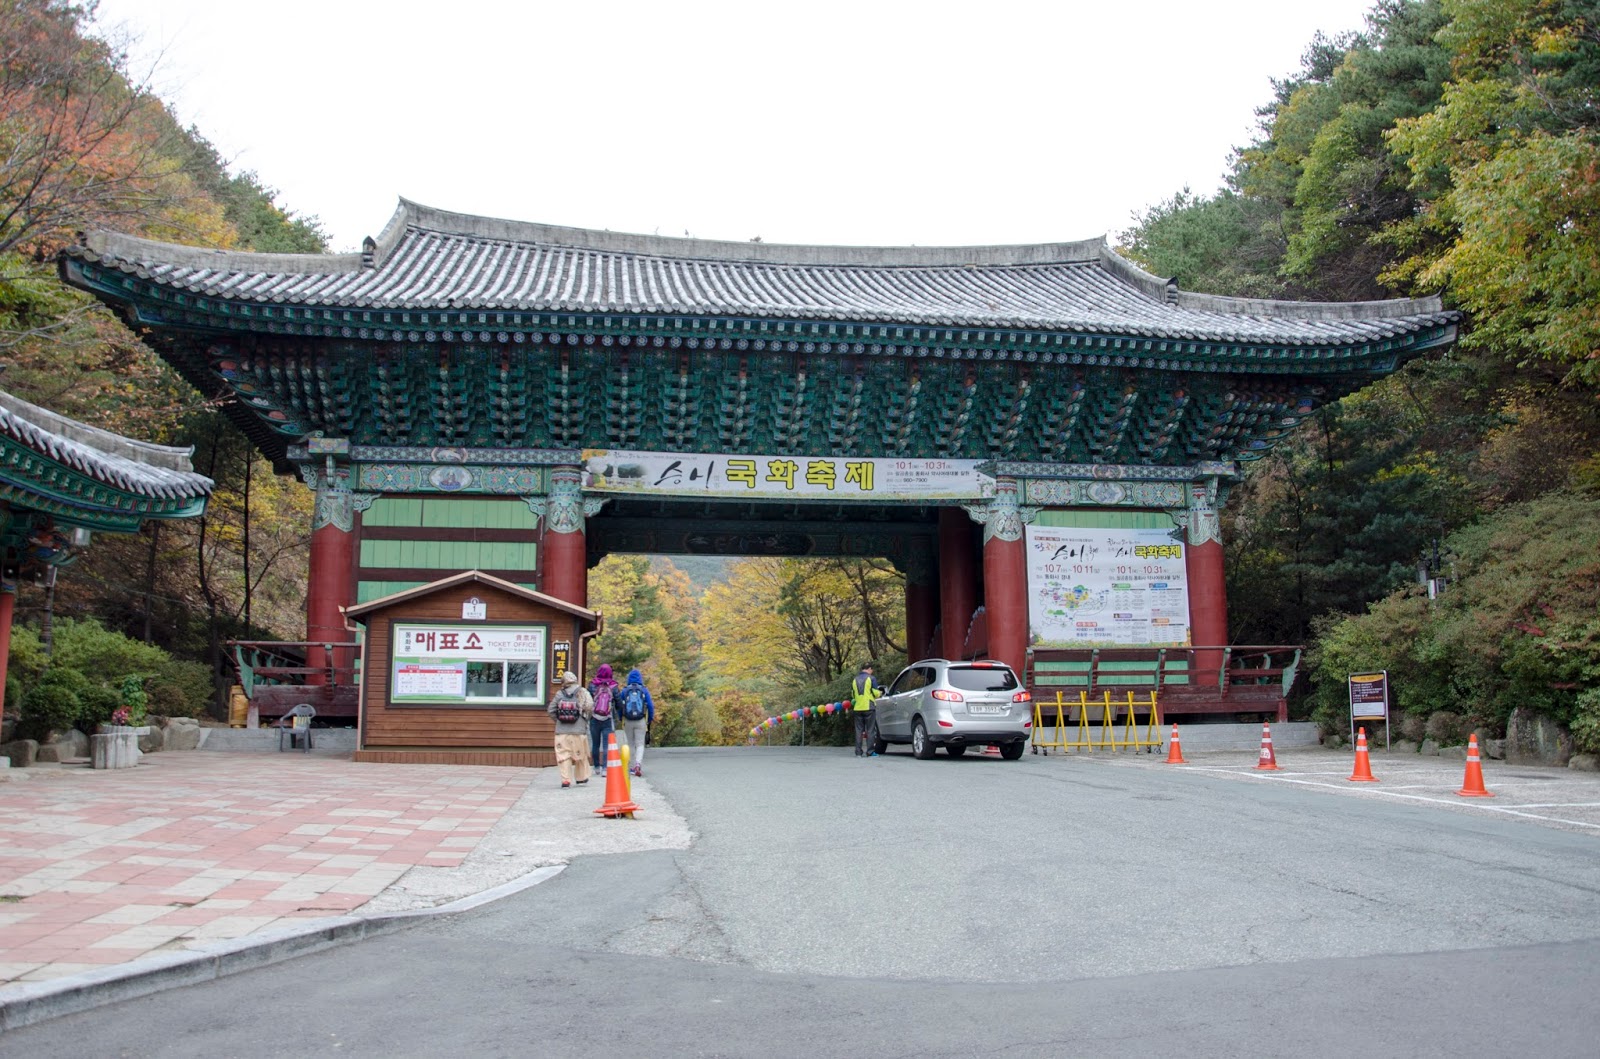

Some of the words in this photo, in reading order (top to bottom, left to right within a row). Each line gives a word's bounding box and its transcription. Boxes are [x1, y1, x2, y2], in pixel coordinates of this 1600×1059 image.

[726, 459, 875, 491] 국화축제
[1134, 544, 1182, 559] 국화축제
[415, 631, 484, 652] 매표소
[487, 640, 511, 648] TICKET
[556, 651, 566, 678] 매표소
